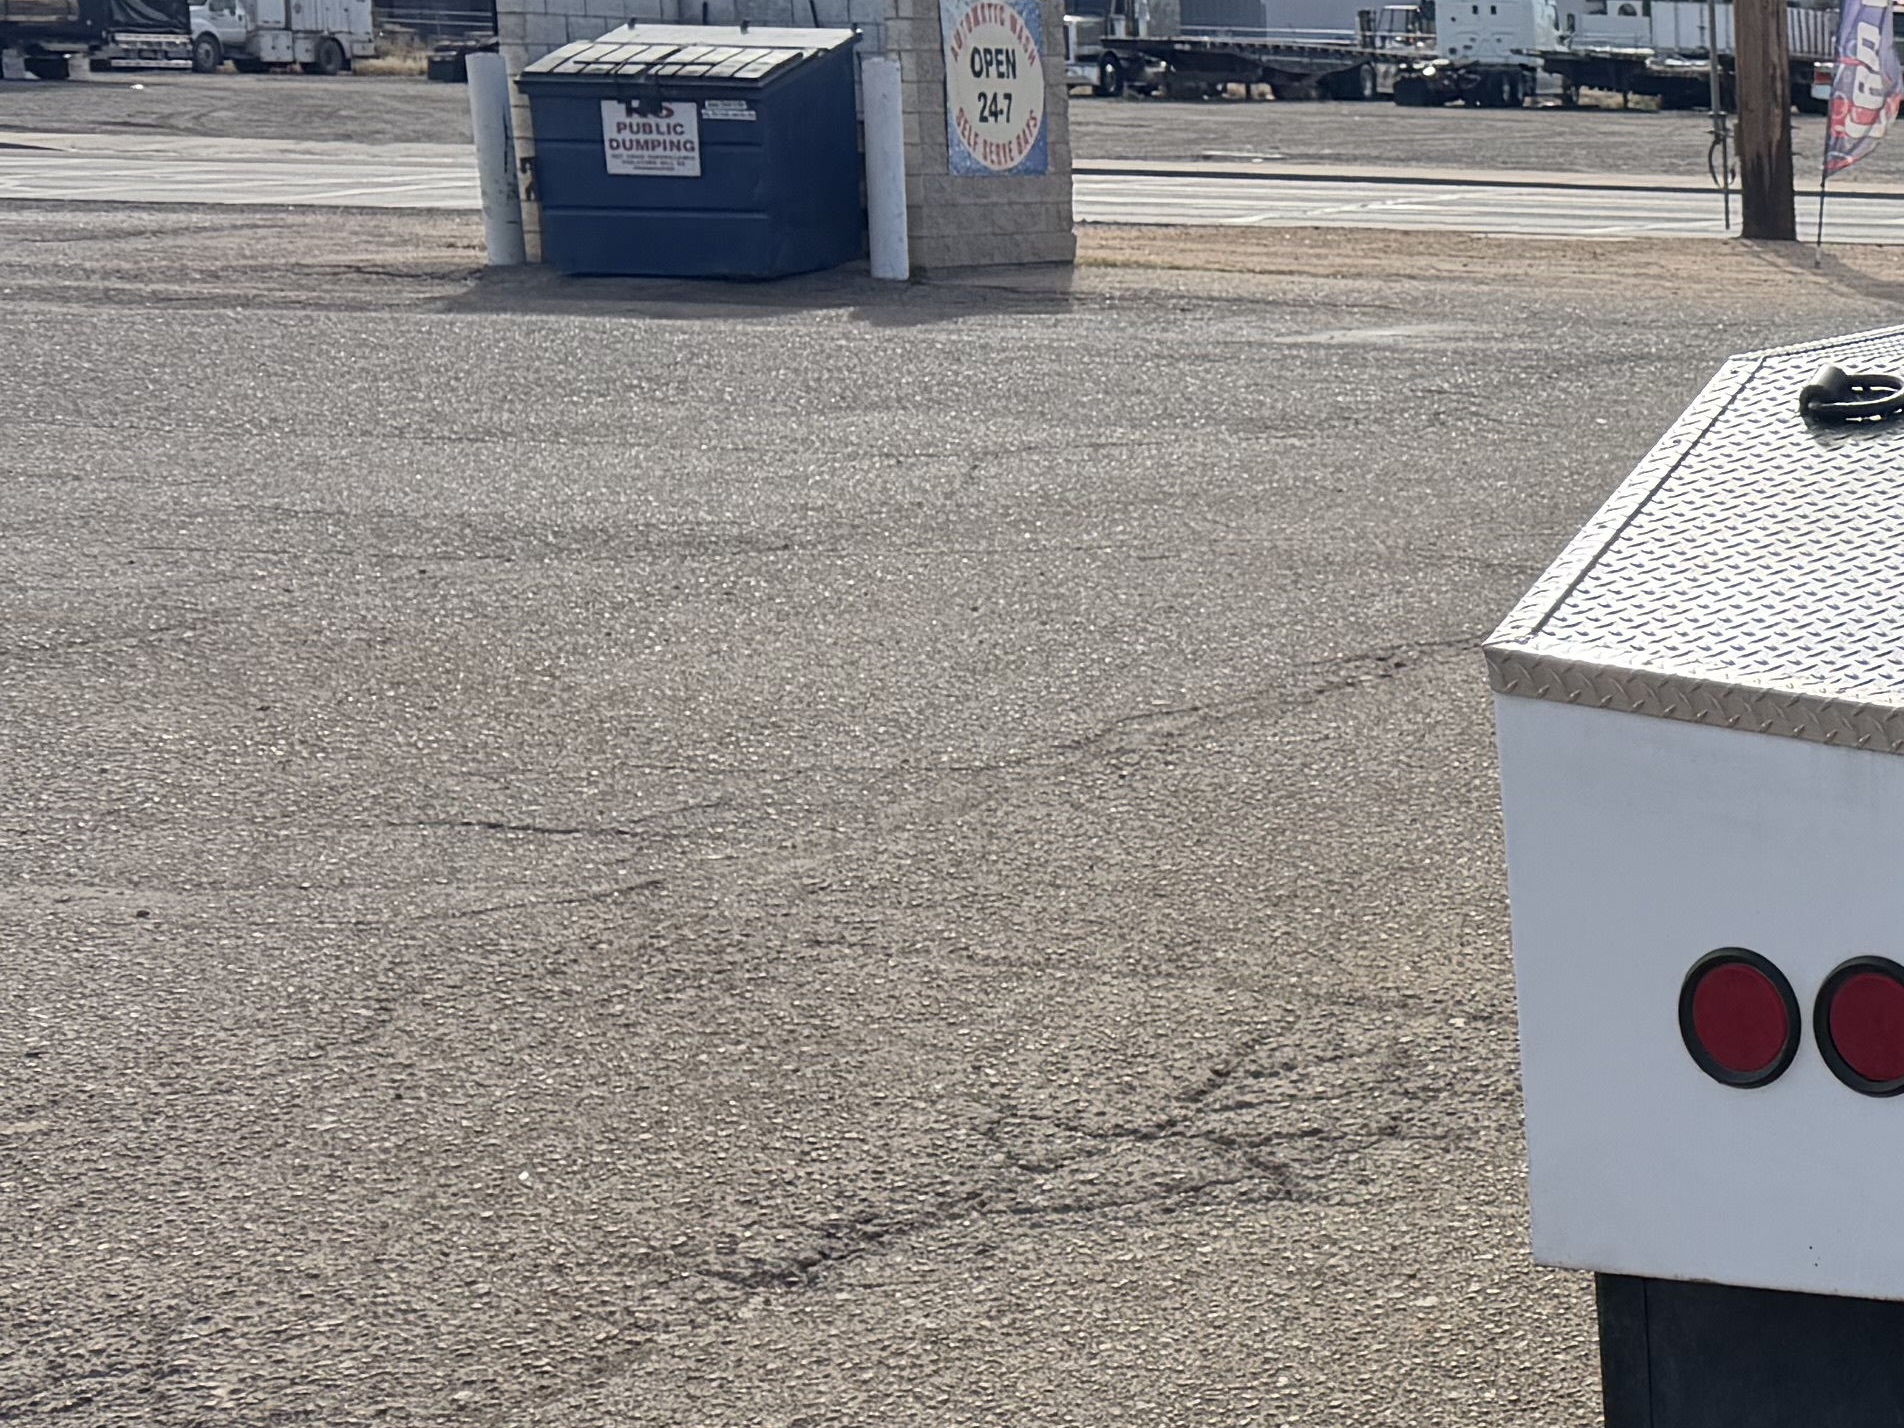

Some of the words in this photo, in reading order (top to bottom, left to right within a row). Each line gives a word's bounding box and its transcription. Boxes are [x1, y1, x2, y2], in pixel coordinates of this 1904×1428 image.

[951, 3, 1005, 63] AUTOMATIC
[1009, 12, 1037, 67] WASH
[970, 46, 1017, 80] OPEN
[977, 91, 1013, 123] 24-7
[608, 138, 696, 152] DUMPING
[616, 122, 685, 135] PUBLIC
[956, 107, 979, 152] SELF
[982, 139, 1015, 166] SERVE
[1016, 109, 1038, 156] BAYS
